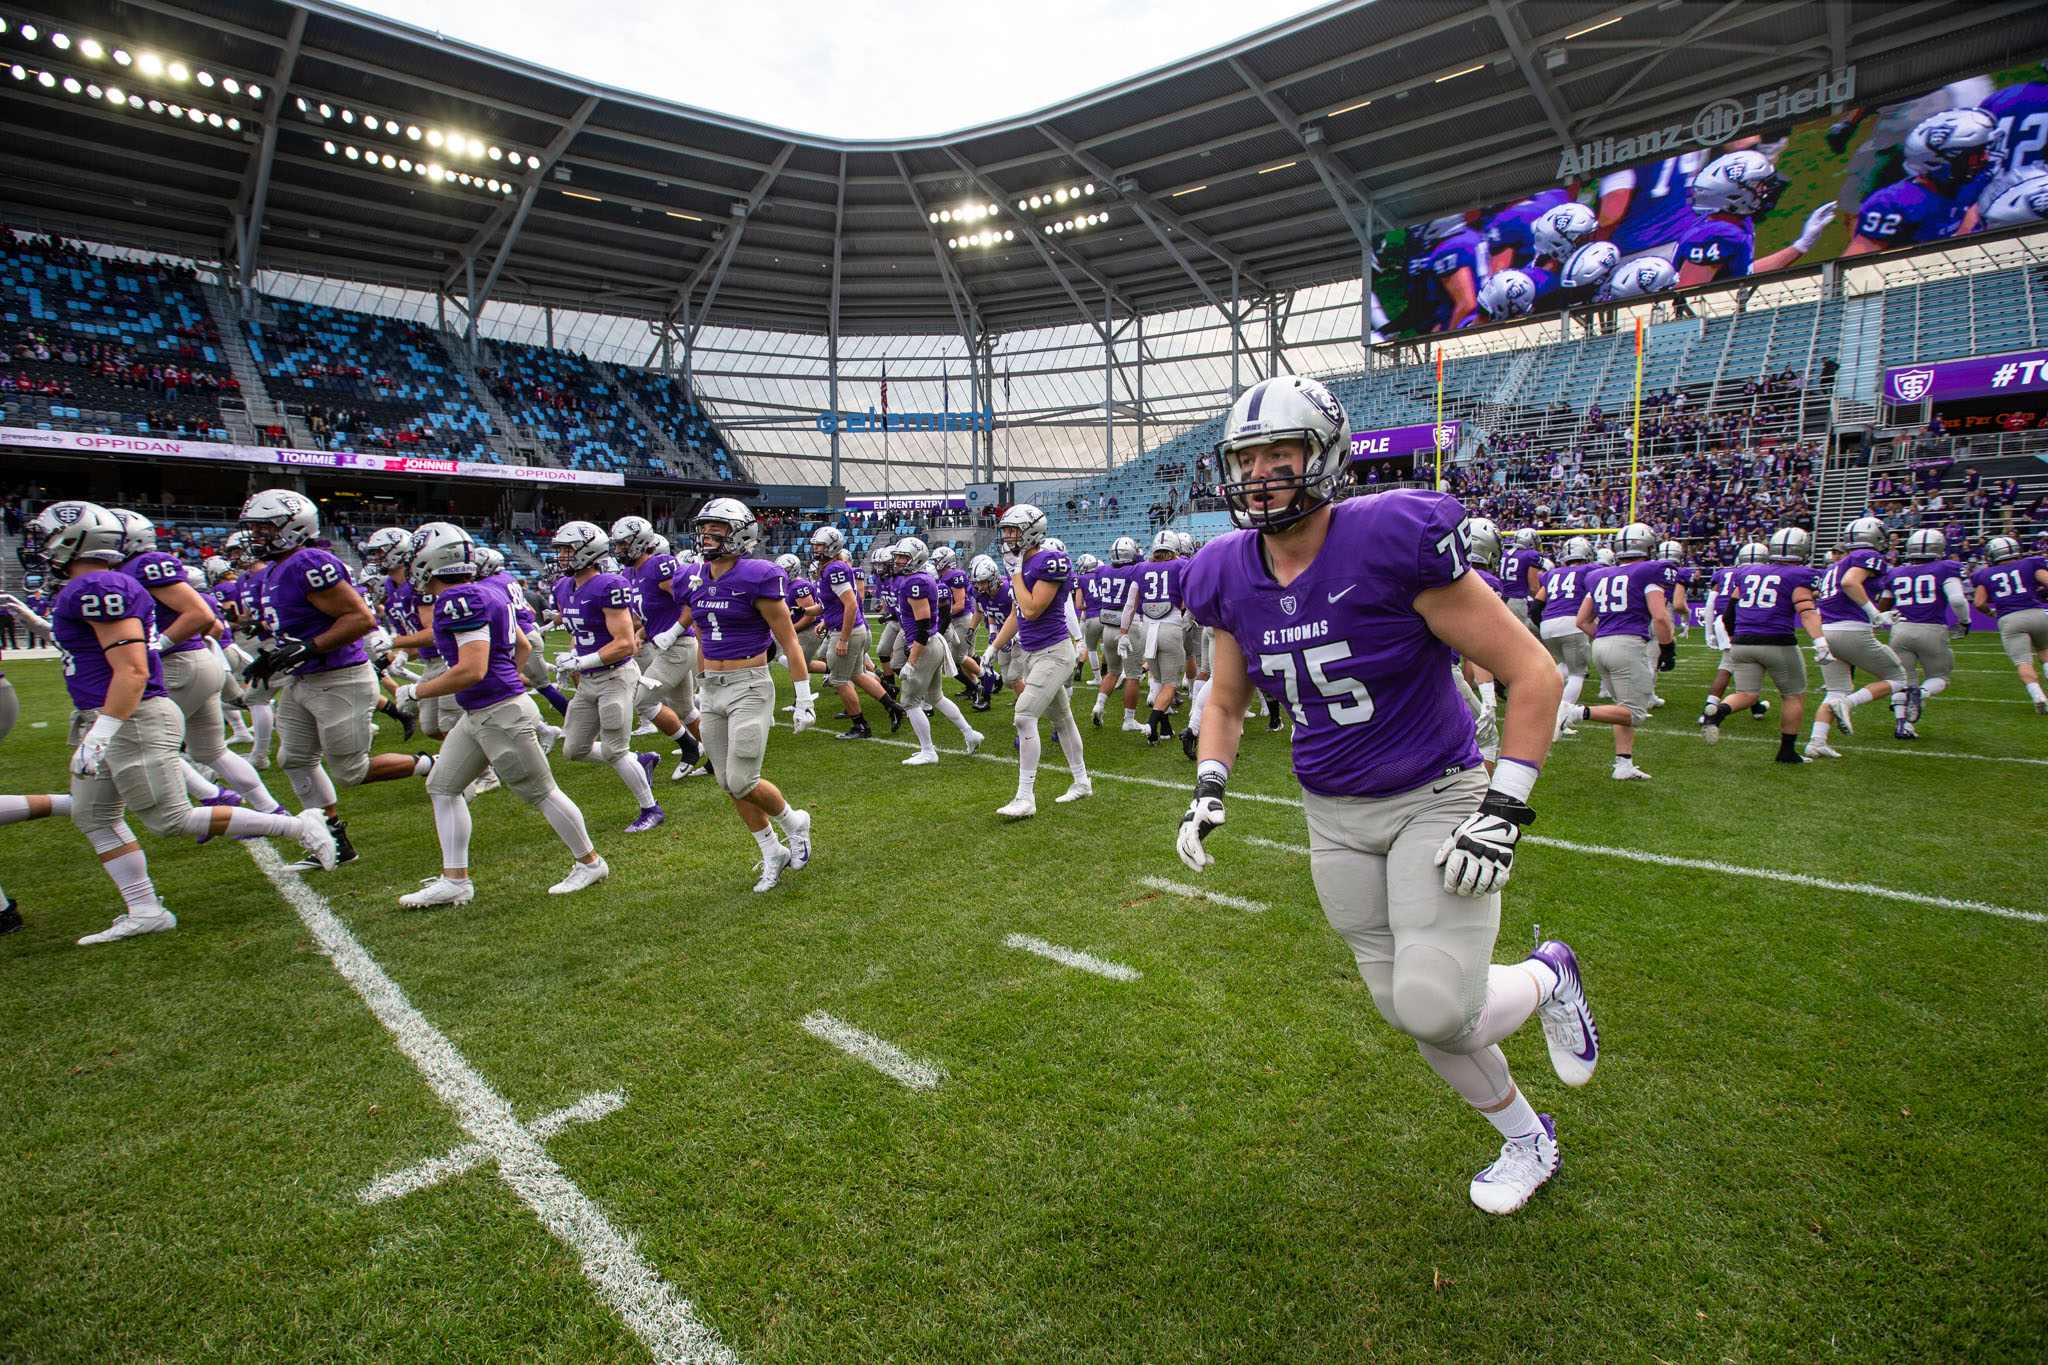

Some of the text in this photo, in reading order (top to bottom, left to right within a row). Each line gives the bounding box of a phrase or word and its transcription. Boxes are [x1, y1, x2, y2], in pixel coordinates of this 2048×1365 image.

[1556, 125, 1683, 180] Allianz
[1756, 65, 1856, 124] Field
[846, 404, 992, 432] element
[76, 436, 181, 453] OPPIDAN
[281, 452, 336, 465] TOMMIE
[403, 459, 454, 471] JOHNNIE
[515, 469, 576, 480] OPPIDAN
[915, 500, 943, 509] ENTRY
[143, 561, 176, 580] 86
[305, 563, 339, 588] 62
[658, 559, 679, 576] 57
[1046, 558, 1068, 573] 35
[1500, 557, 1519, 581] 12
[1865, 557, 1883, 571] 41
[778, 576, 785, 596] 1
[829, 571, 846, 584] 55
[953, 575, 965, 584] 34
[1144, 571, 1170, 600] 31
[1548, 571, 1577, 600] 44
[1819, 566, 1839, 599] 41
[1990, 569, 2028, 598] 31
[611, 587, 632, 605] 25
[797, 586, 810, 597] 56
[911, 585, 920, 597] 9
[1101, 577, 1126, 604] 27
[1593, 575, 1629, 613] 49
[1738, 575, 1782, 608] 36
[1893, 574, 1937, 606] 20
[80, 593, 125, 617] 28
[443, 596, 474, 620] 41
[705, 601, 729, 609] THOMAS
[707, 612, 722, 641] 1
[1263, 620, 1329, 646] ST. THOMAS
[1258, 639, 1376, 728] 75
